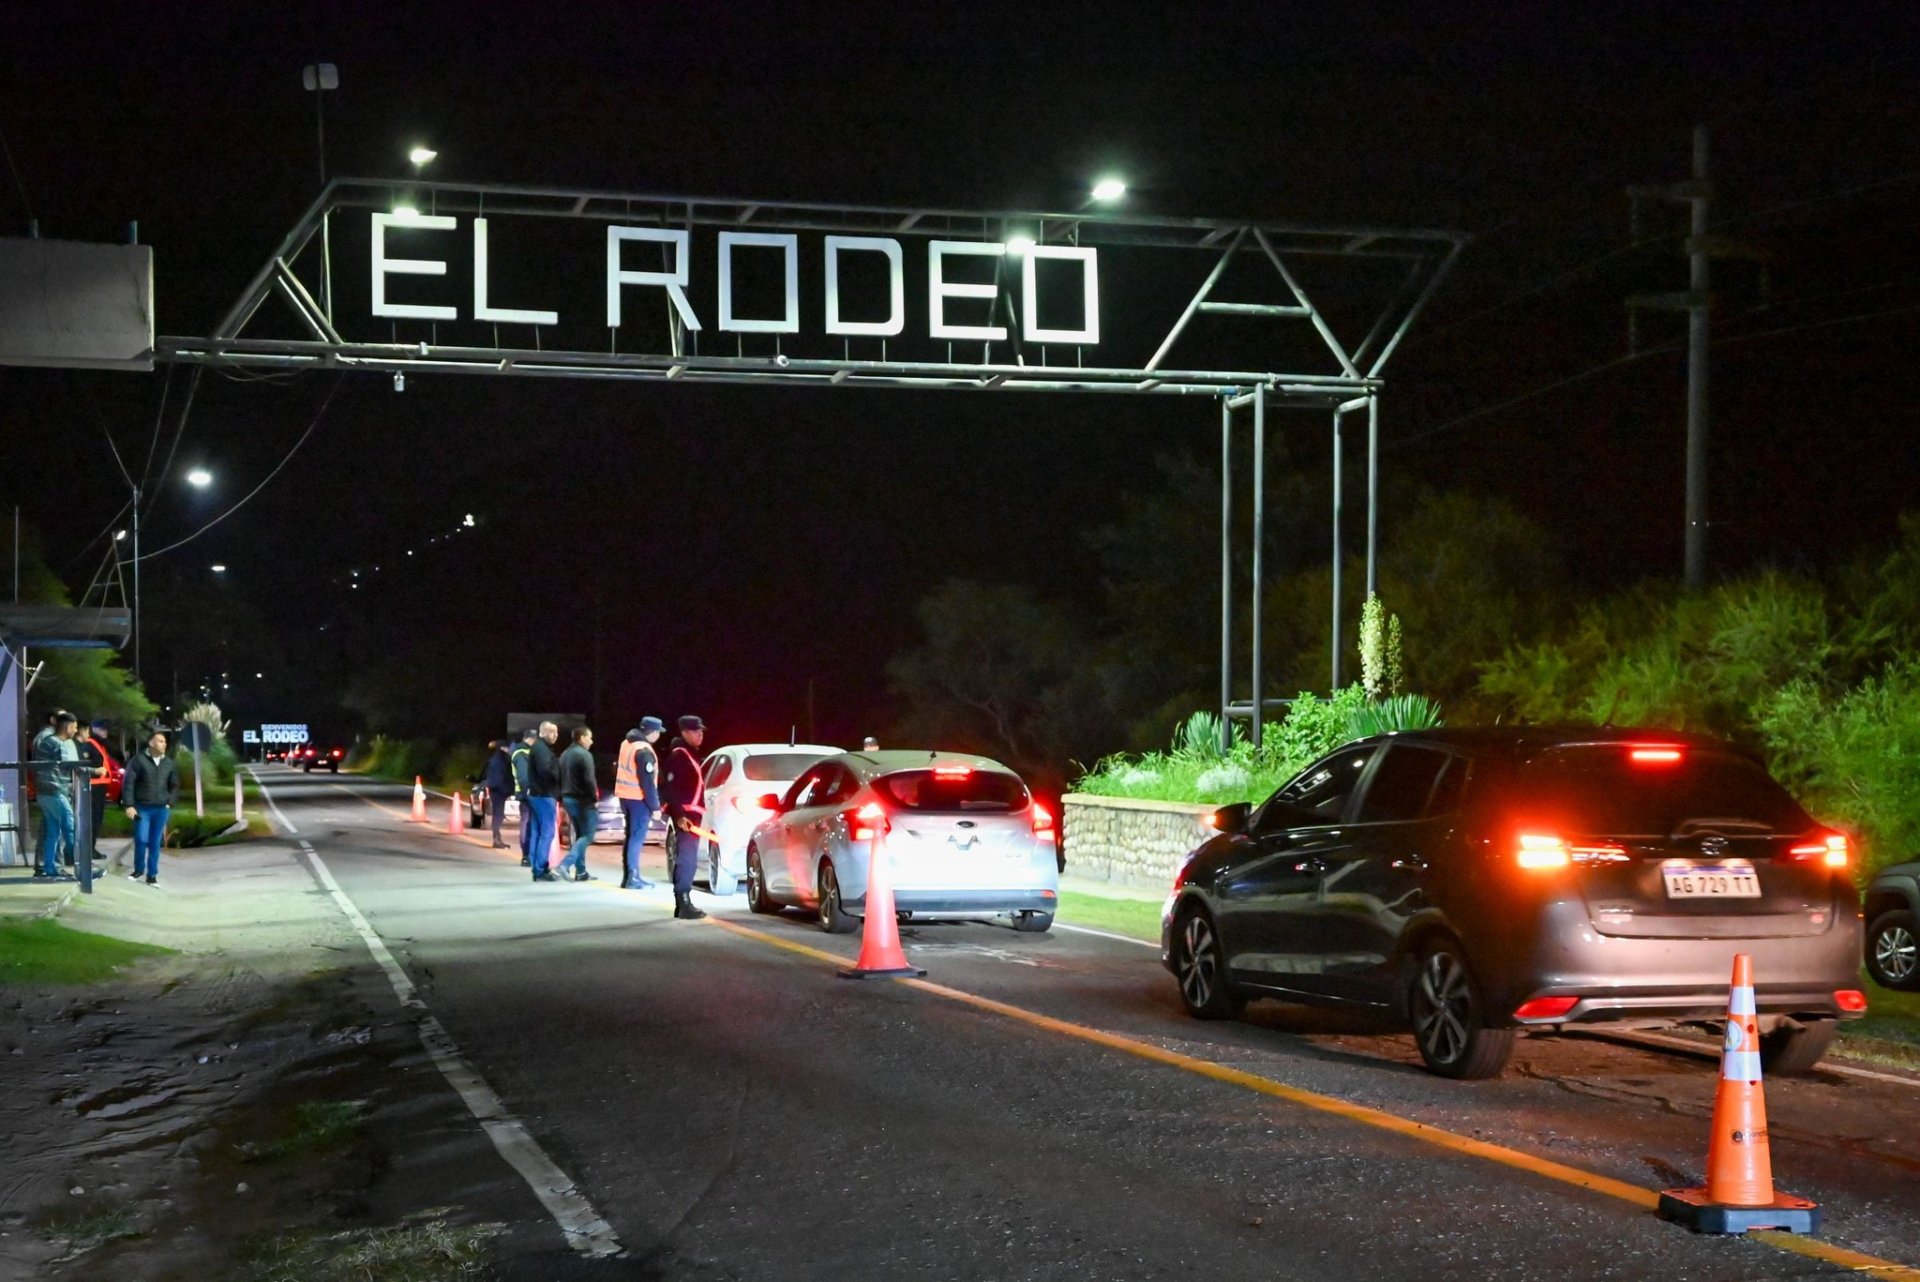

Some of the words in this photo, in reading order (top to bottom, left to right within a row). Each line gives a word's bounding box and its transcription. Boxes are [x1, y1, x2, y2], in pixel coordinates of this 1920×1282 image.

[371, 212, 558, 325] EL
[607, 225, 1100, 344] RODEO
[243, 730, 260, 743] EL
[263, 730, 309, 743] RODEO
